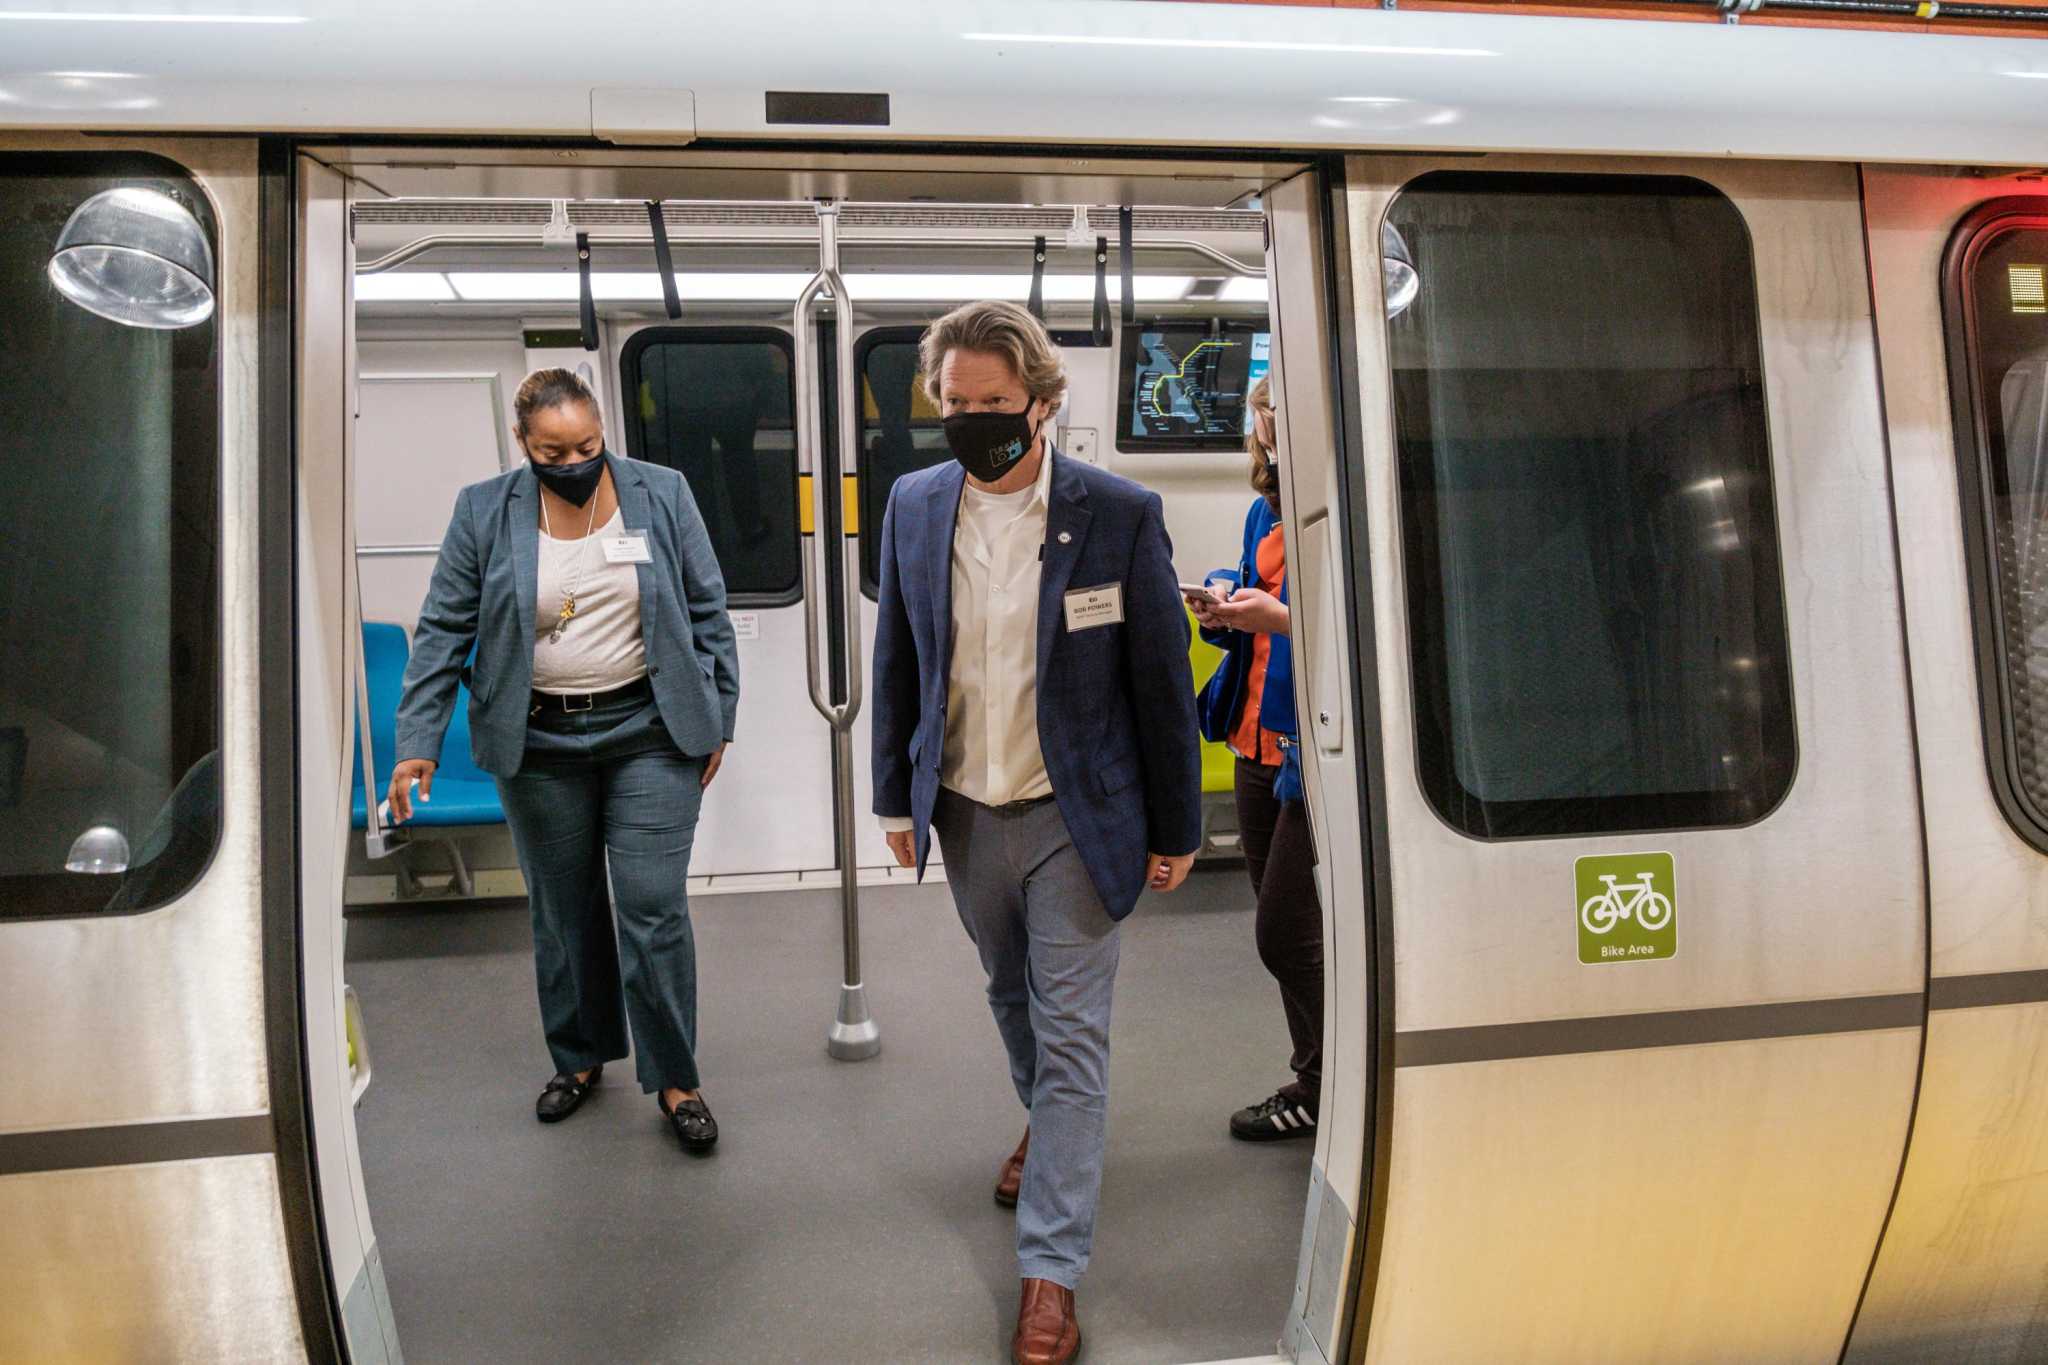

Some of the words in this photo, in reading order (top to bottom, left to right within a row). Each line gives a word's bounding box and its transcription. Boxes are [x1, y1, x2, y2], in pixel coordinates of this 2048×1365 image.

[1087, 602, 1112, 611] POWERS
[1601, 945, 1625, 957] Bike
[1628, 944, 1655, 956] Area
